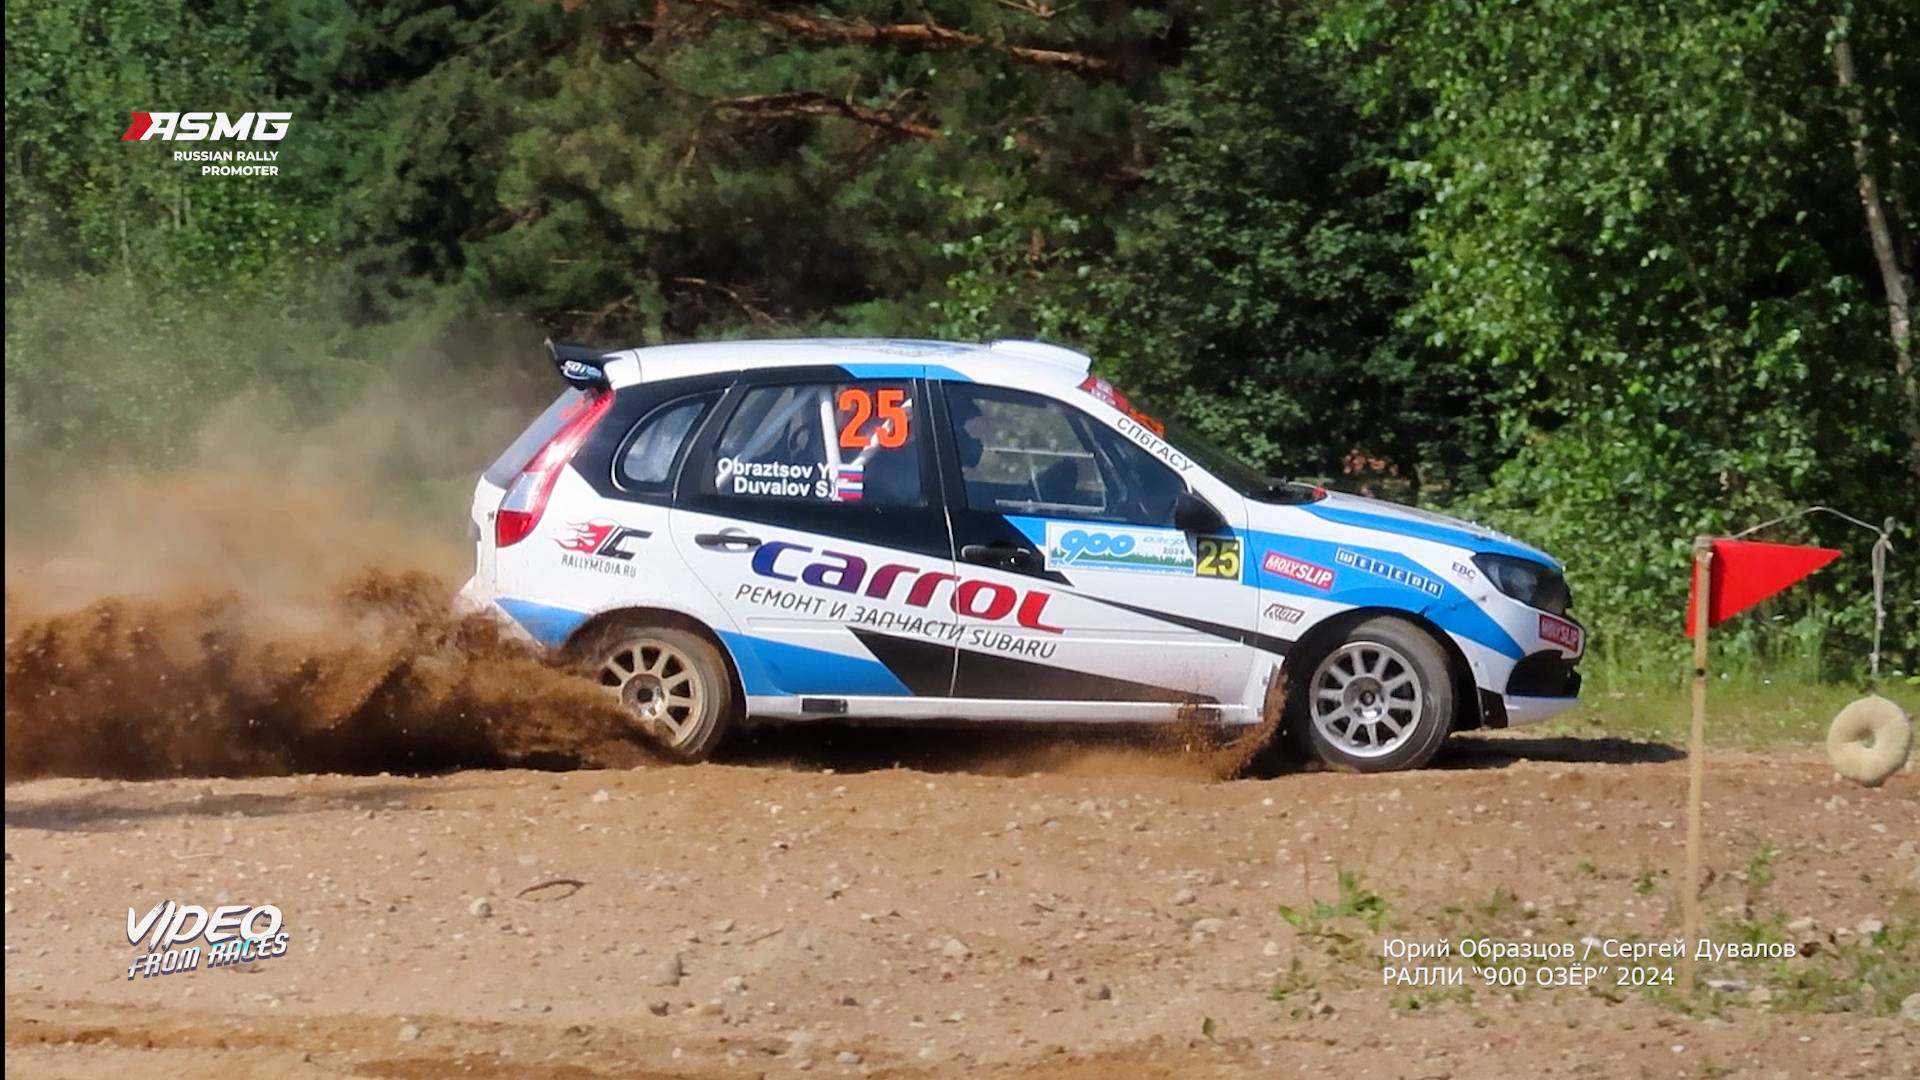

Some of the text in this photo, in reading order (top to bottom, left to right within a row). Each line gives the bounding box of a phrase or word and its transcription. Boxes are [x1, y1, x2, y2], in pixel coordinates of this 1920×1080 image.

[838, 388, 909, 448] 25
[717, 457, 813, 479] Obraztsov
[733, 476, 811, 496] Duvalov
[1060, 529, 1135, 564] 900
[1197, 540, 1239, 577] 25
[561, 554, 637, 578] RALLYMEDIA.RU
[1264, 553, 1333, 586] MOLYSLIP
[1451, 561, 1477, 581] EBC
[734, 583, 1056, 659] РЕМОНТ И ЗАПЧАСТИ SUBARU
